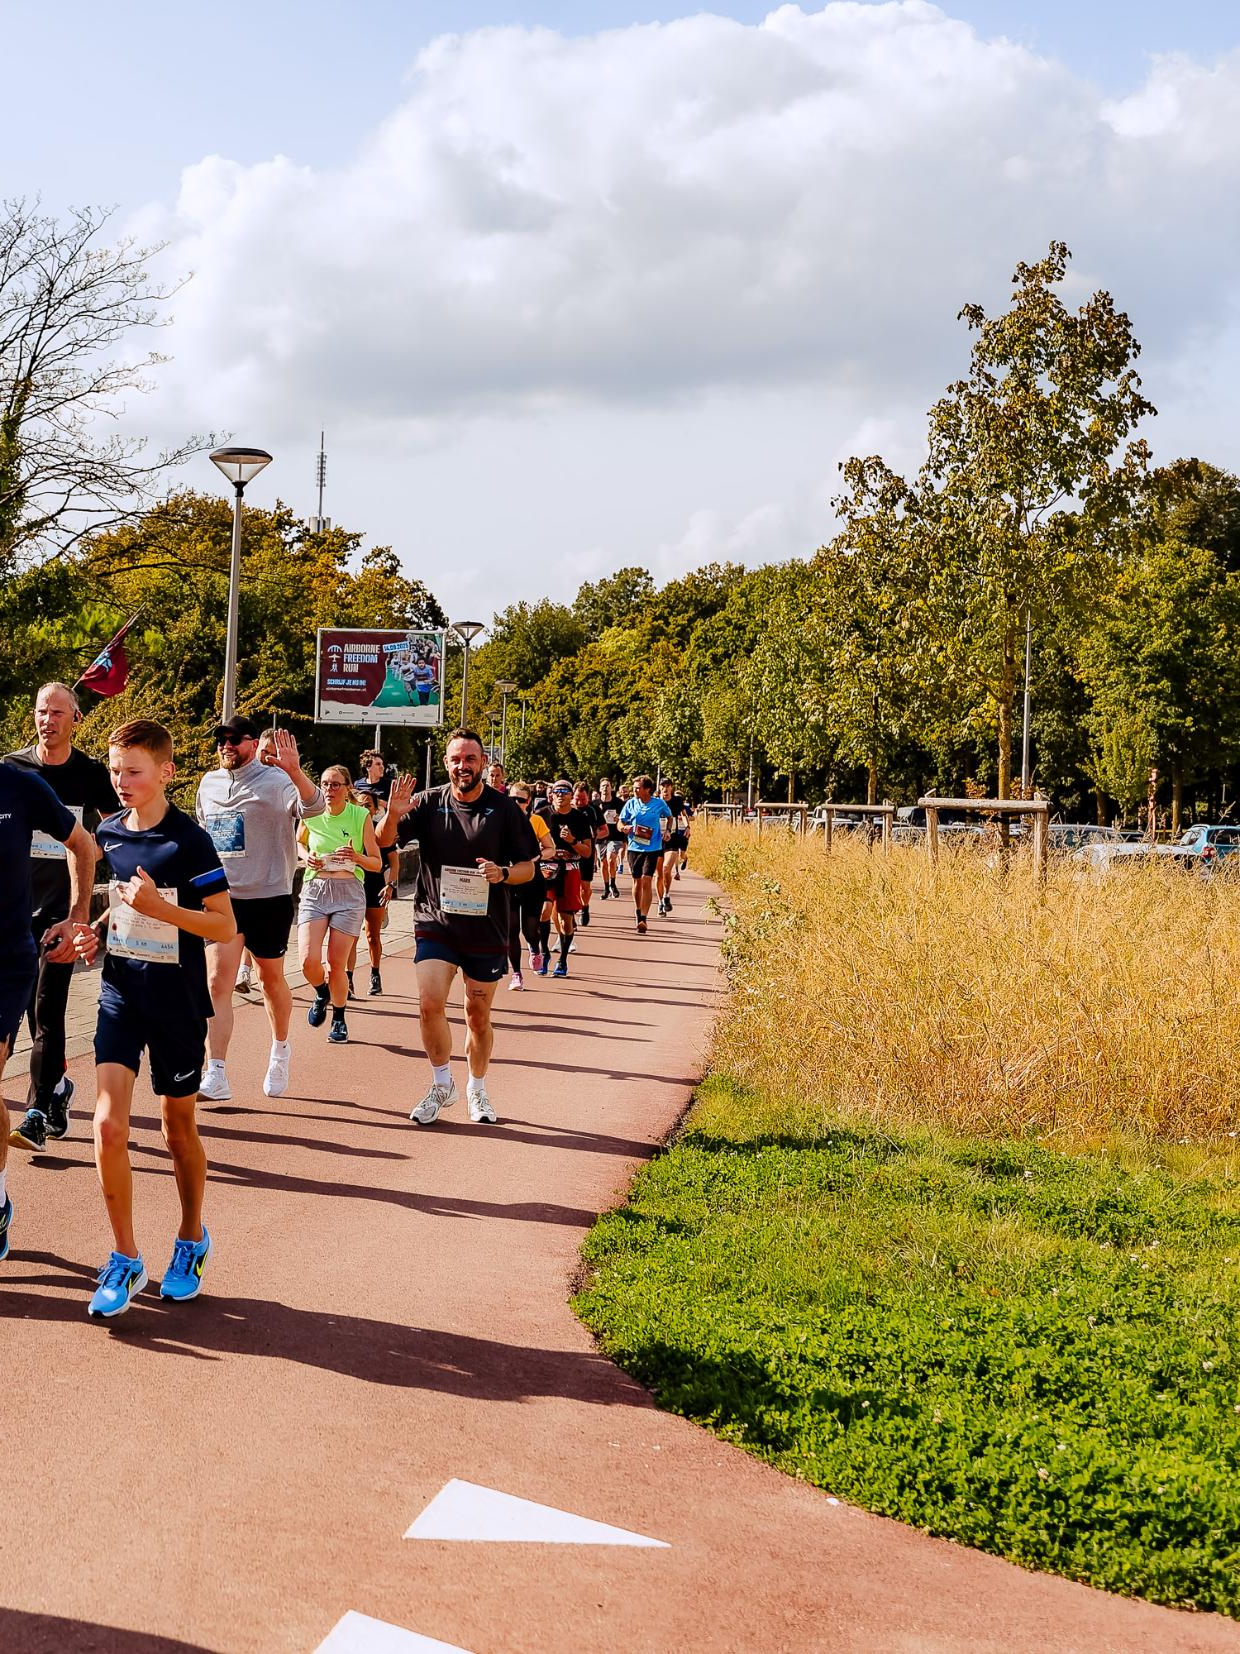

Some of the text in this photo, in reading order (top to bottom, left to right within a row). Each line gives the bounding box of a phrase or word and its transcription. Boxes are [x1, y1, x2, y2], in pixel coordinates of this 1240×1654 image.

[344, 643, 380, 654] AIRBORNE
[343, 653, 378, 664] FREEDOM
[343, 663, 359, 673] RUN
